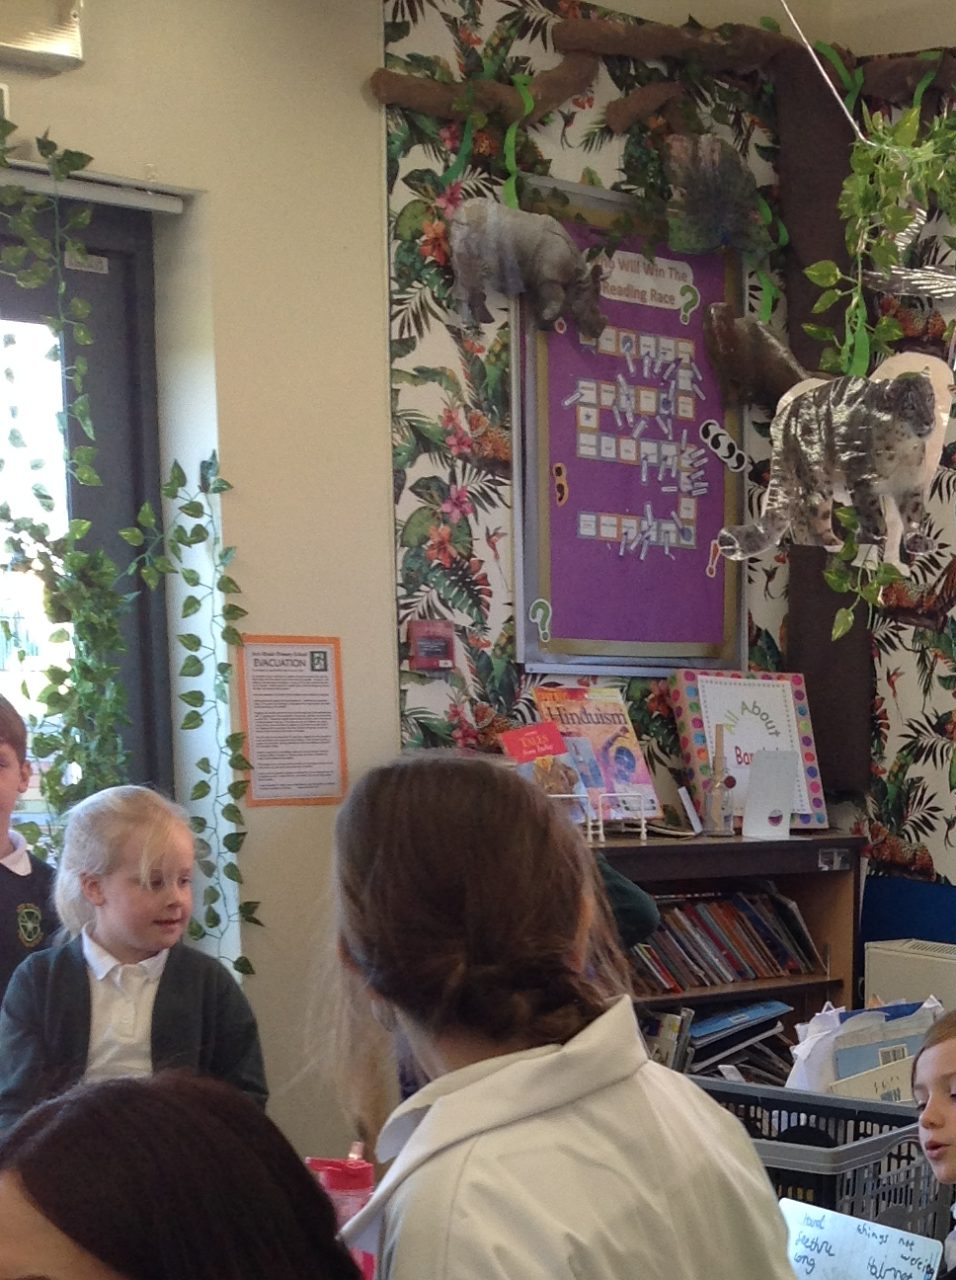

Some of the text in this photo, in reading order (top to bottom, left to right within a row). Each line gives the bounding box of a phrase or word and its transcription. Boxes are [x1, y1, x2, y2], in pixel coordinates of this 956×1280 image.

[618, 258, 640, 273] Will
[668, 267, 688, 282] The
[602, 280, 675, 305] Reading Race
[548, 706, 628, 725] Hinduism
[741, 700, 781, 737] About
